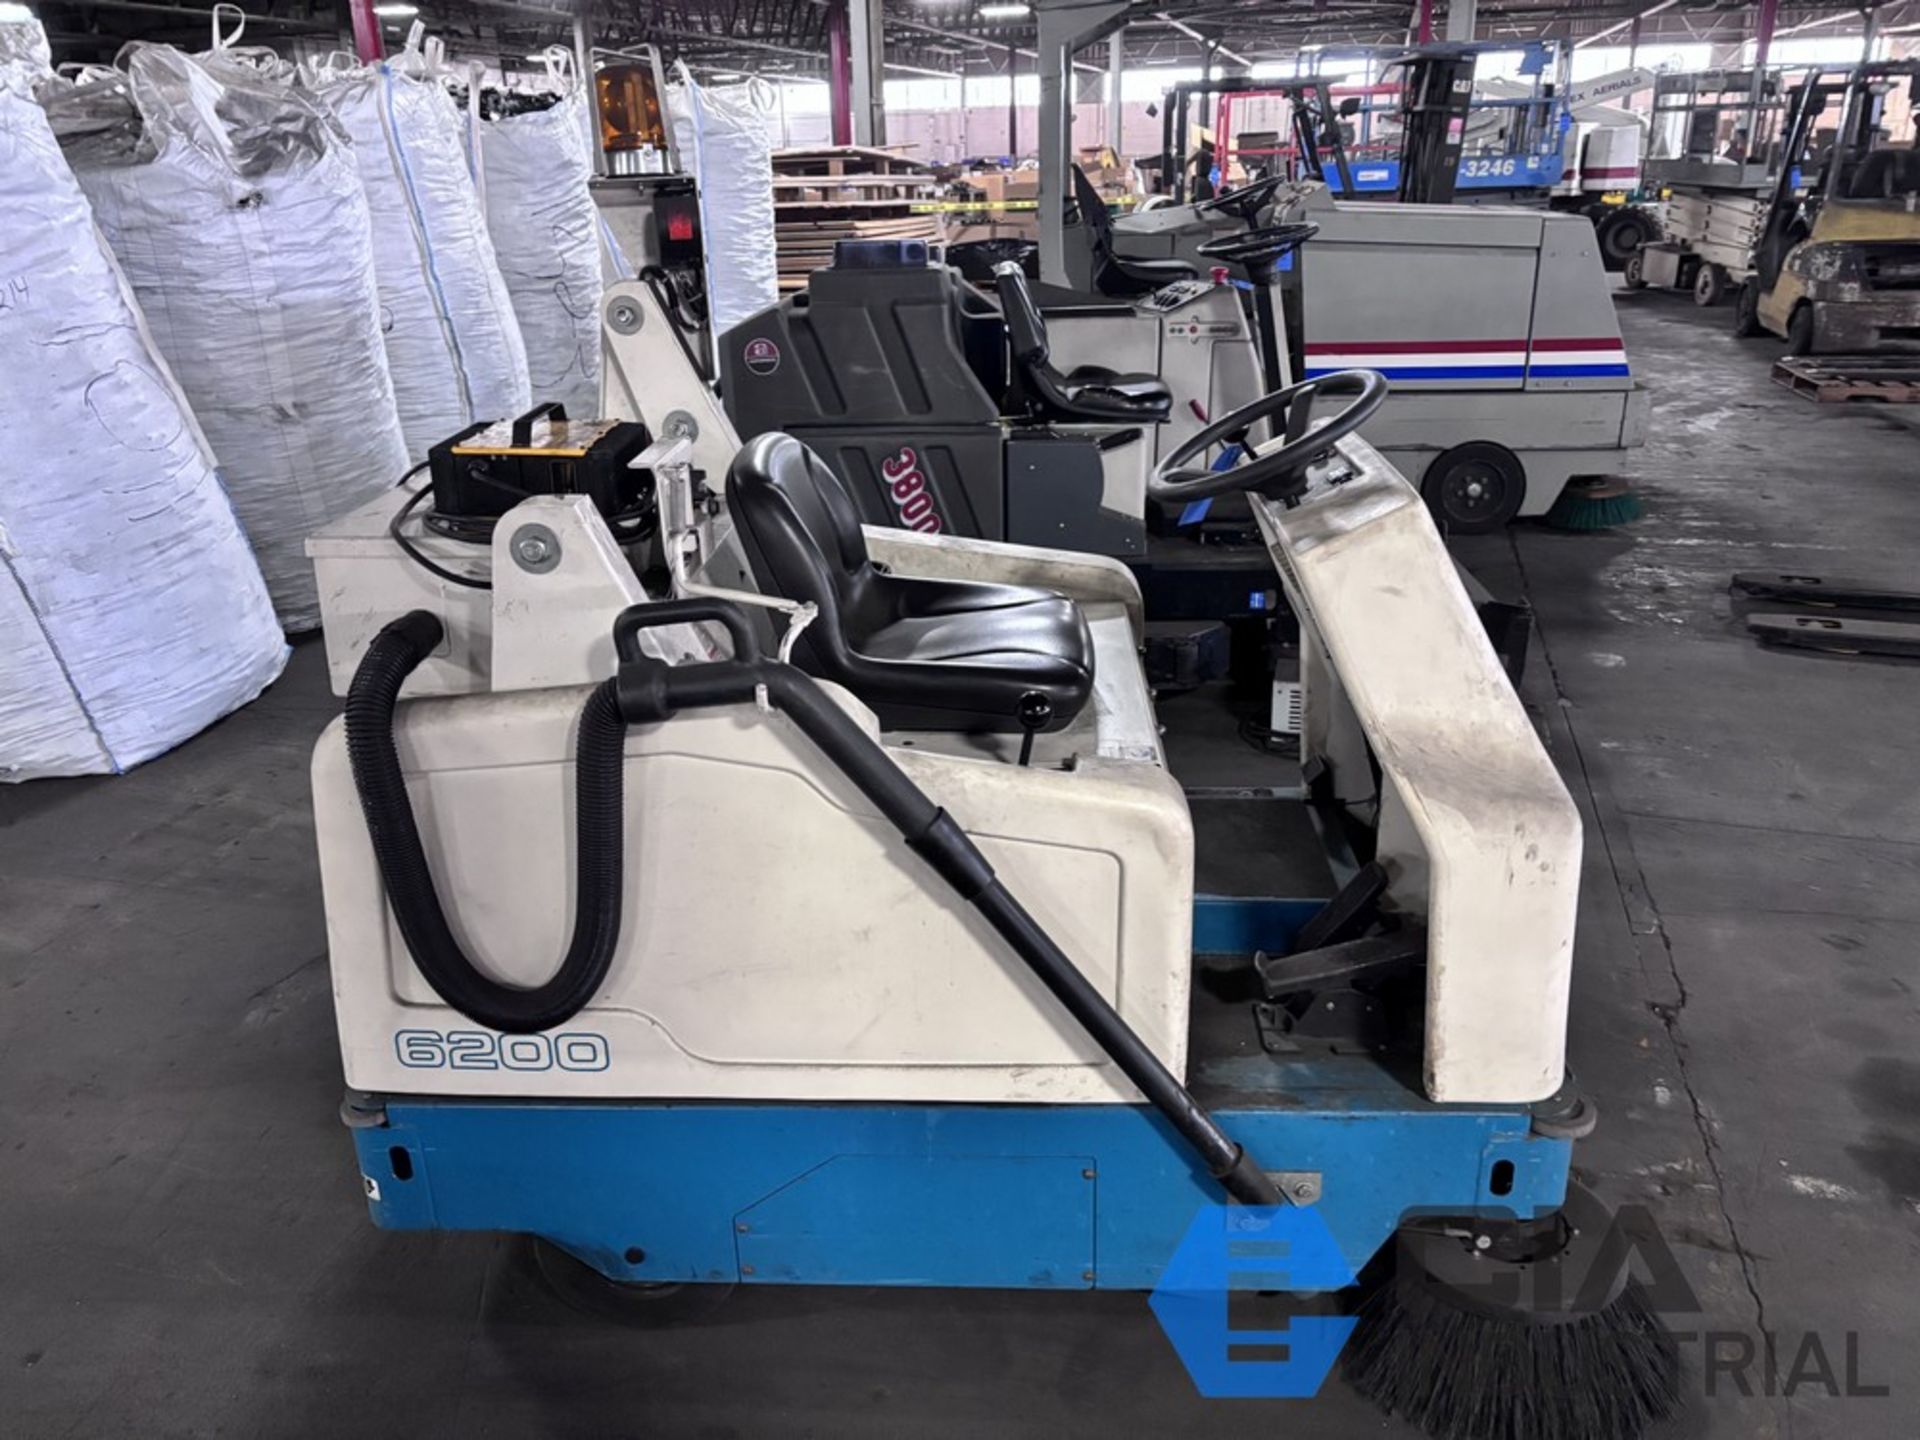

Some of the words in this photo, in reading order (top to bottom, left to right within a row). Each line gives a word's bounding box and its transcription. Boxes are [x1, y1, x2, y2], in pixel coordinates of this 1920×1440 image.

[1593, 76, 1642, 97] AERIALS
[1460, 159, 1515, 177] -3246
[395, 1029, 610, 1072] 6200
